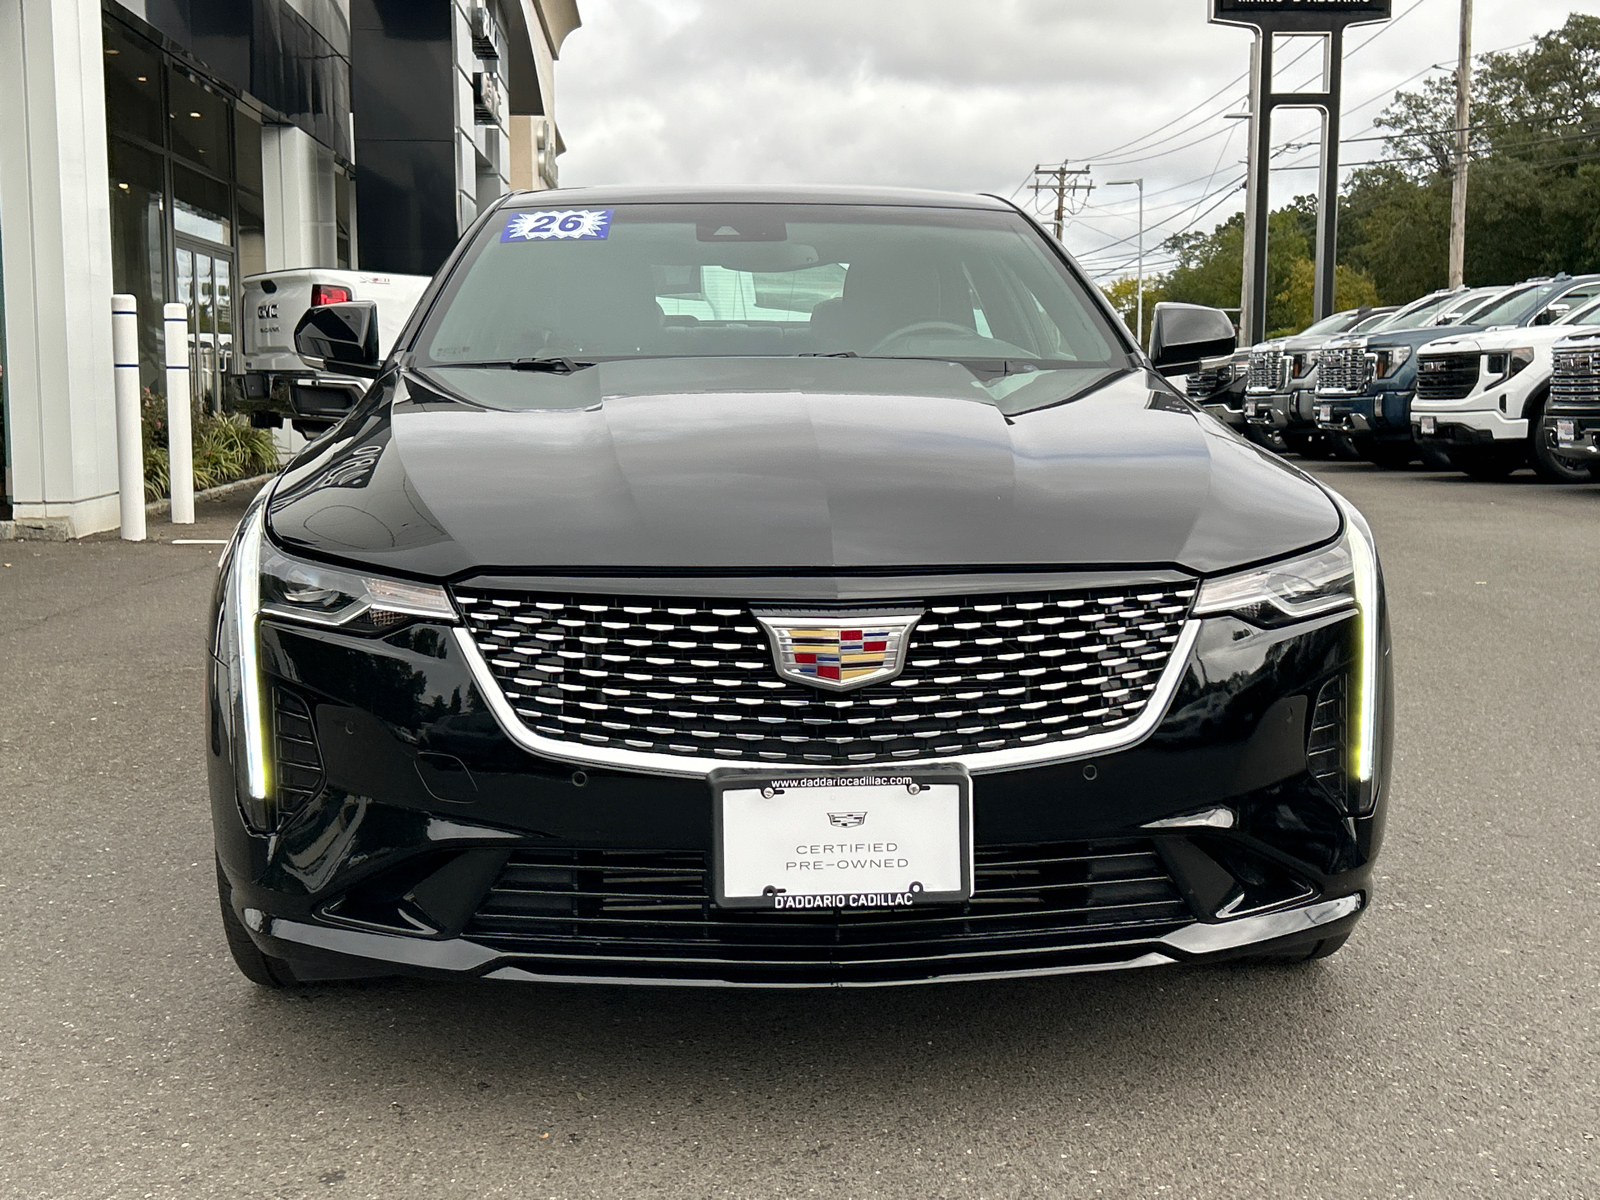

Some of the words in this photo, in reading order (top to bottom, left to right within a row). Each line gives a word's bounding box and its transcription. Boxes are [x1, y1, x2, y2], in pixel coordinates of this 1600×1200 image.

[528, 214, 585, 233] 26
[771, 776, 912, 788] www.daddariocadillac.com
[796, 843, 898, 855] CERTIFIED
[785, 858, 909, 871] PRE-OWNED
[774, 894, 845, 909] D'ADDARIO
[849, 893, 913, 907] CADILLAC
